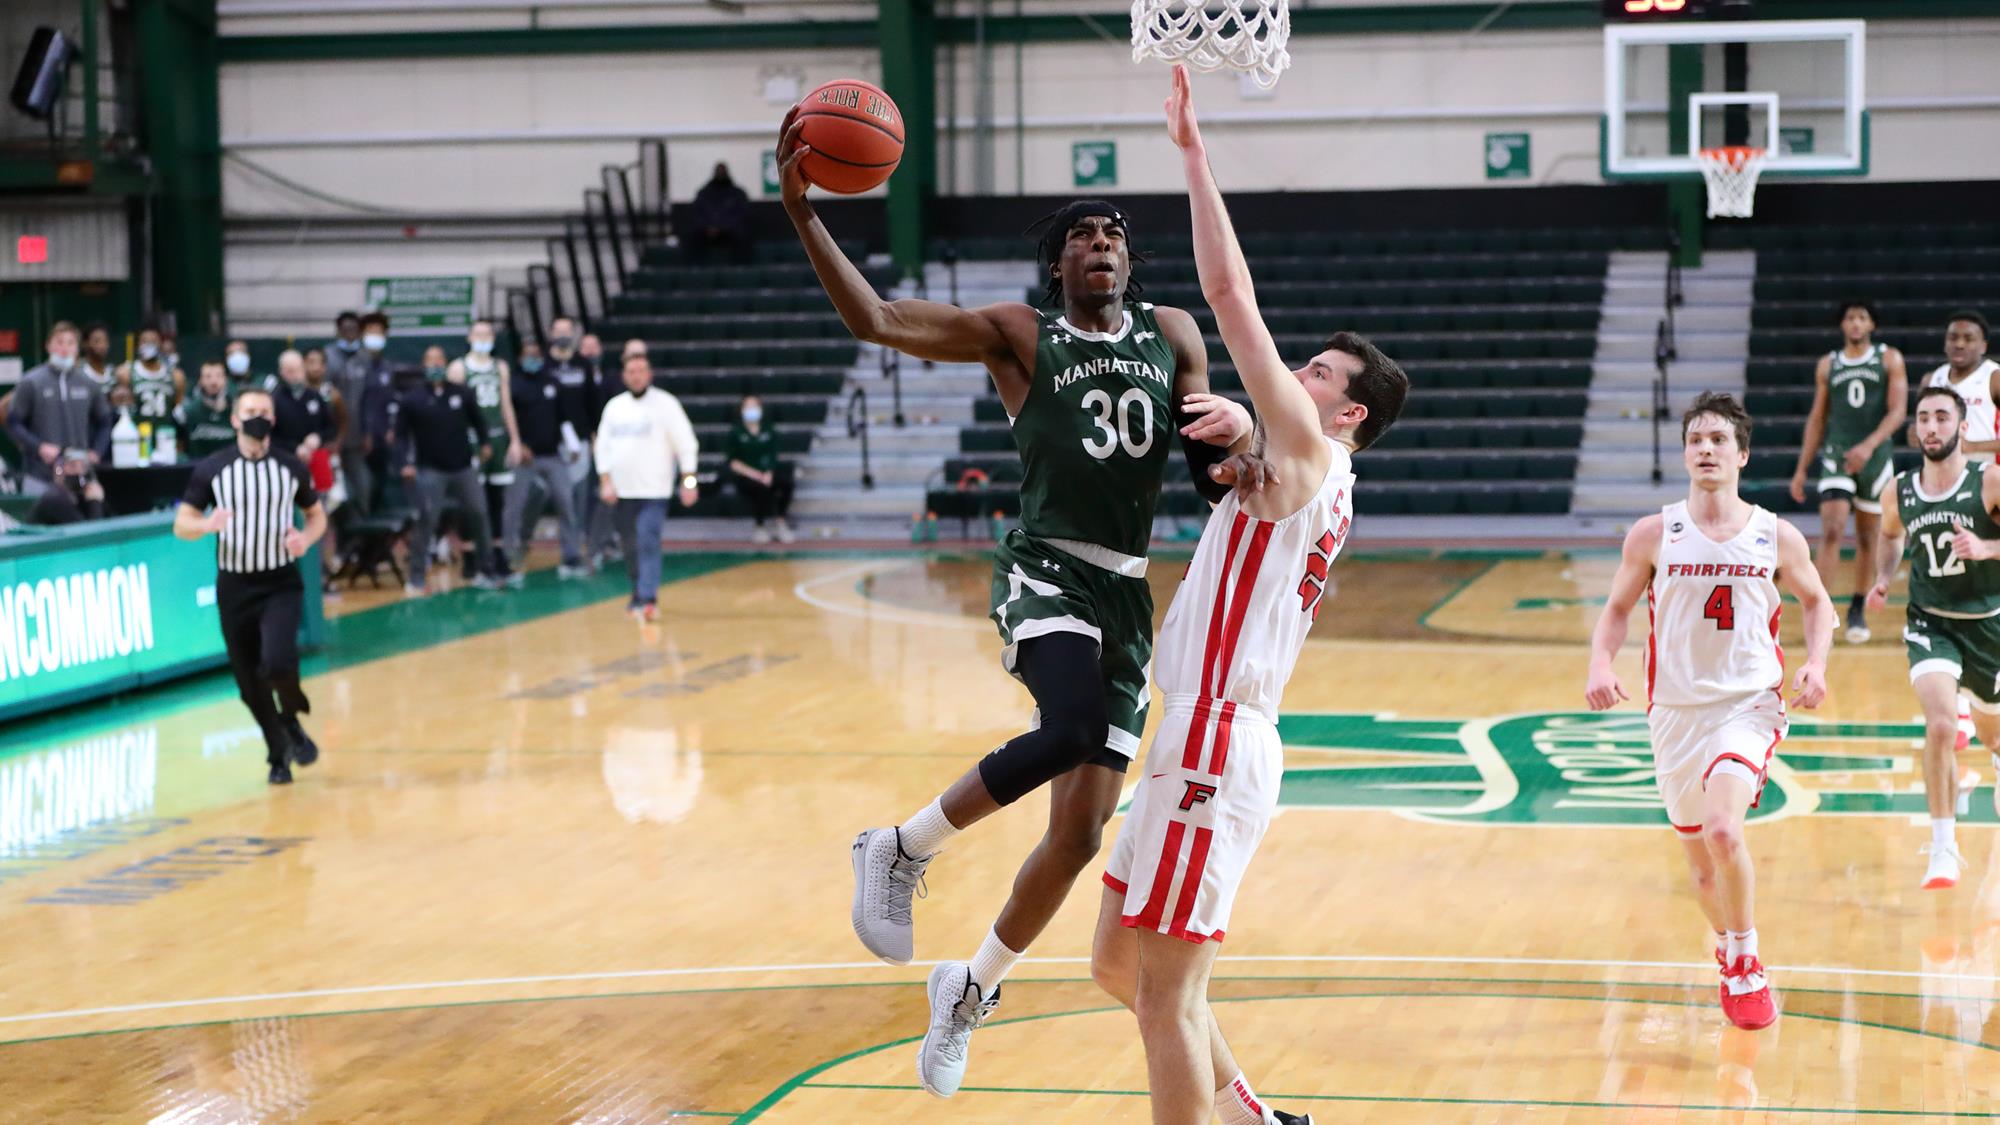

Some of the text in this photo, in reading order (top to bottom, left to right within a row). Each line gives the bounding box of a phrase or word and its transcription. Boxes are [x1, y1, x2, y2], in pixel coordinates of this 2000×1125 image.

[818, 87, 860, 110] ROCK
[1053, 357, 1169, 393] MANHATTAN
[1848, 379, 1866, 409] 0
[1080, 387, 1154, 460] 30
[1907, 510, 1975, 537] MANHATTAN
[1920, 531, 1967, 578] 12
[1704, 585, 1735, 631] 4
[1178, 780, 1218, 811] F
